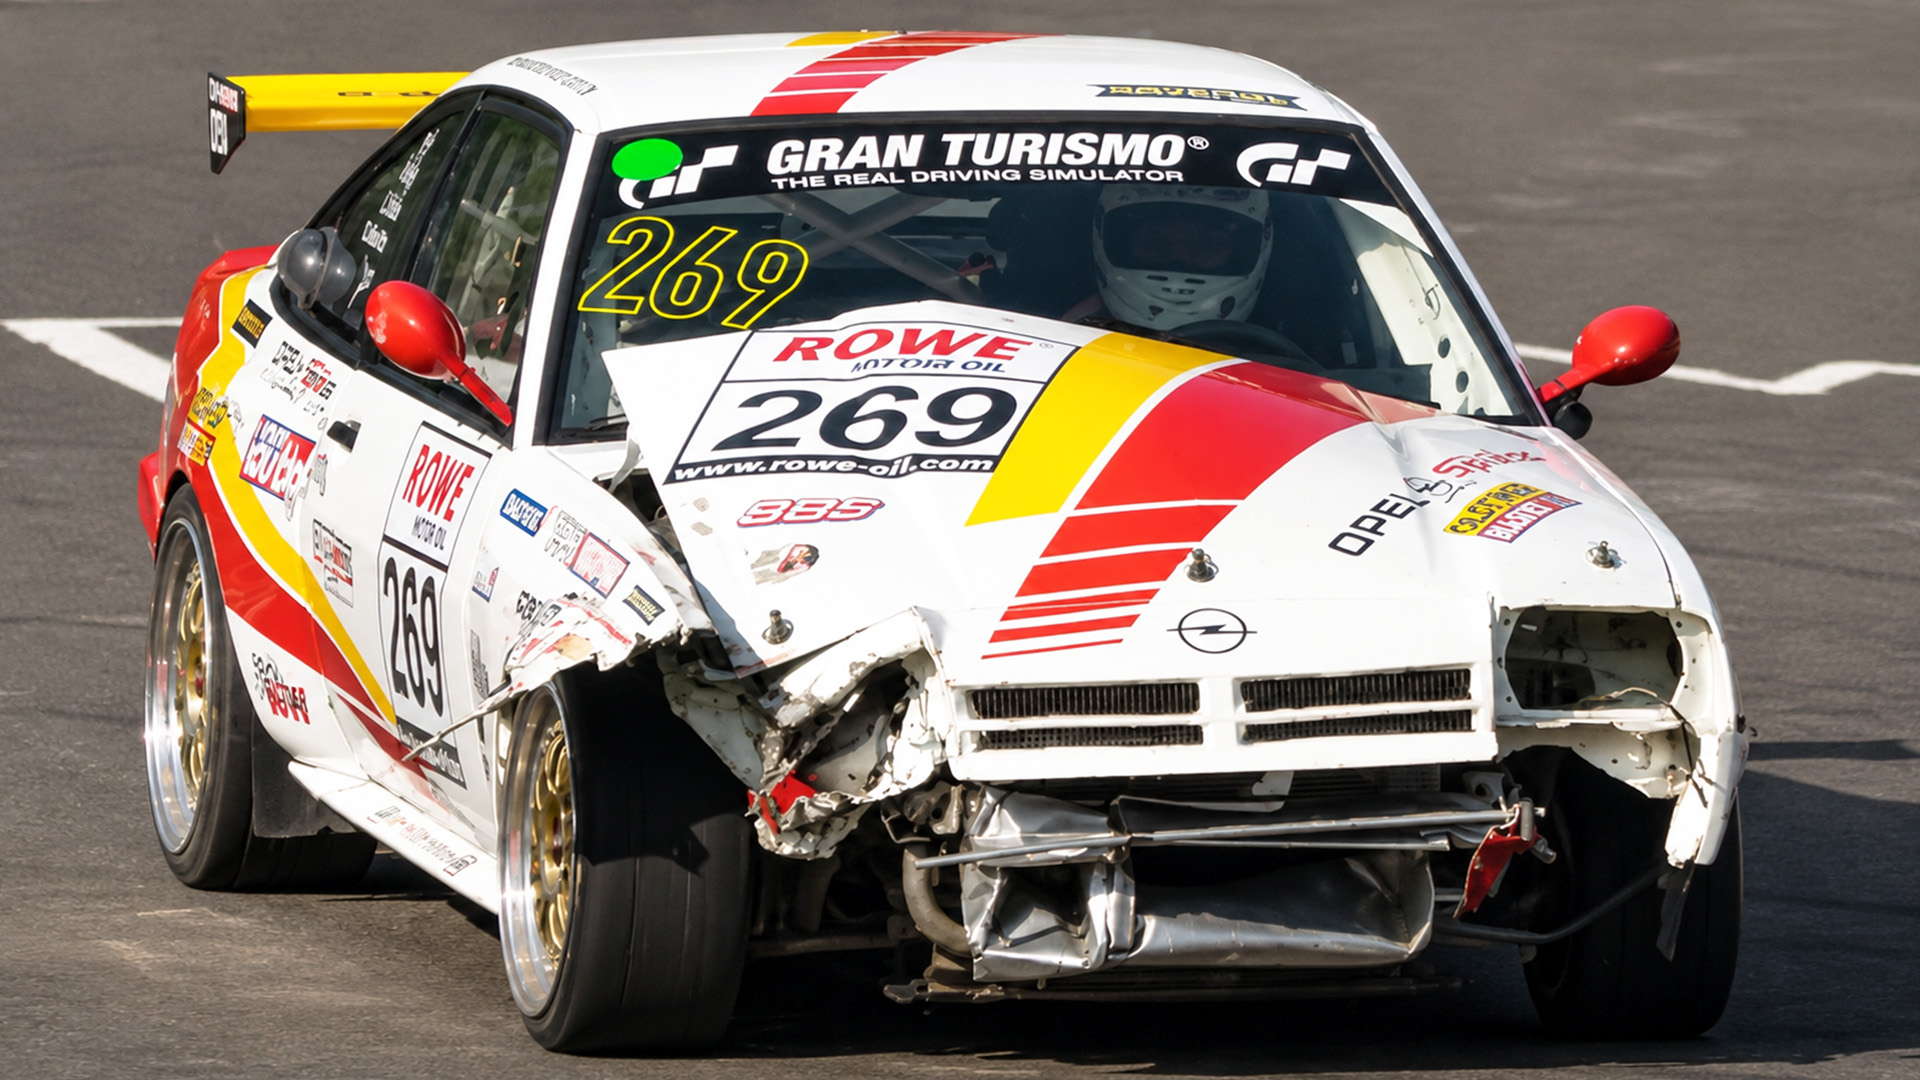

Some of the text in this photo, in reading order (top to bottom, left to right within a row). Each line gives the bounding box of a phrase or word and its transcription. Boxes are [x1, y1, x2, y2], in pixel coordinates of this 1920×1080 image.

[766, 134, 925, 175] GRAN
[1236, 142, 1351, 188] GT
[771, 169, 1184, 190] THE REAL DRIVING SIMULATOR
[577, 215, 810, 331] 269
[772, 328, 1033, 362] ROWE
[961, 361, 1006, 373] OIL
[711, 385, 1018, 452] 269
[402, 444, 475, 522] ROWE
[674, 455, 994, 482] www.rowe-oil.com
[1327, 493, 1431, 557] OPEL
[383, 556, 445, 718] 269
